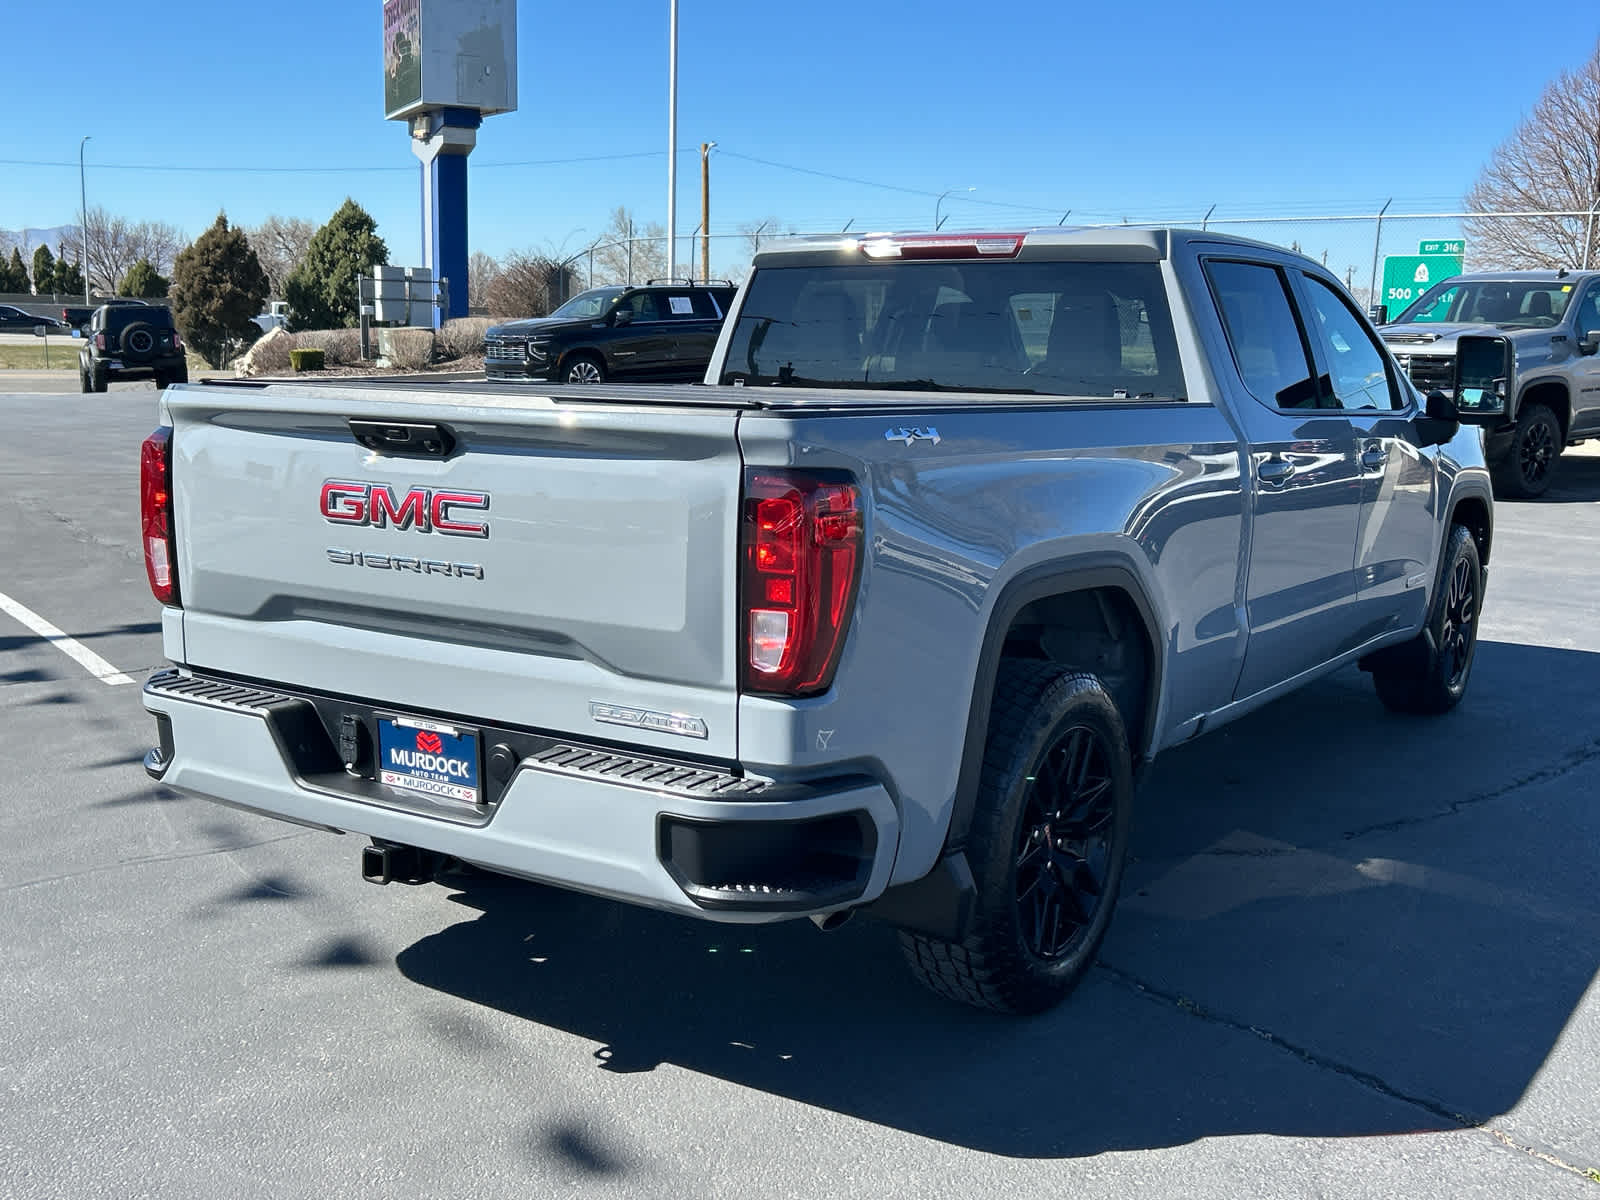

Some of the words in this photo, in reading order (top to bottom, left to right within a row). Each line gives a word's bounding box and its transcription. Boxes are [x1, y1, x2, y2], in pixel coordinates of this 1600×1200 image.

[1443, 243, 1459, 252] 316
[1388, 288, 1412, 300] 500
[320, 478, 491, 539] GMC
[326, 548, 485, 580] SIERRA
[390, 747, 470, 779] MURDOCK
[410, 769, 429, 778] AUTO
[431, 773, 449, 782] TEAM
[403, 777, 455, 796] MURDOCK
